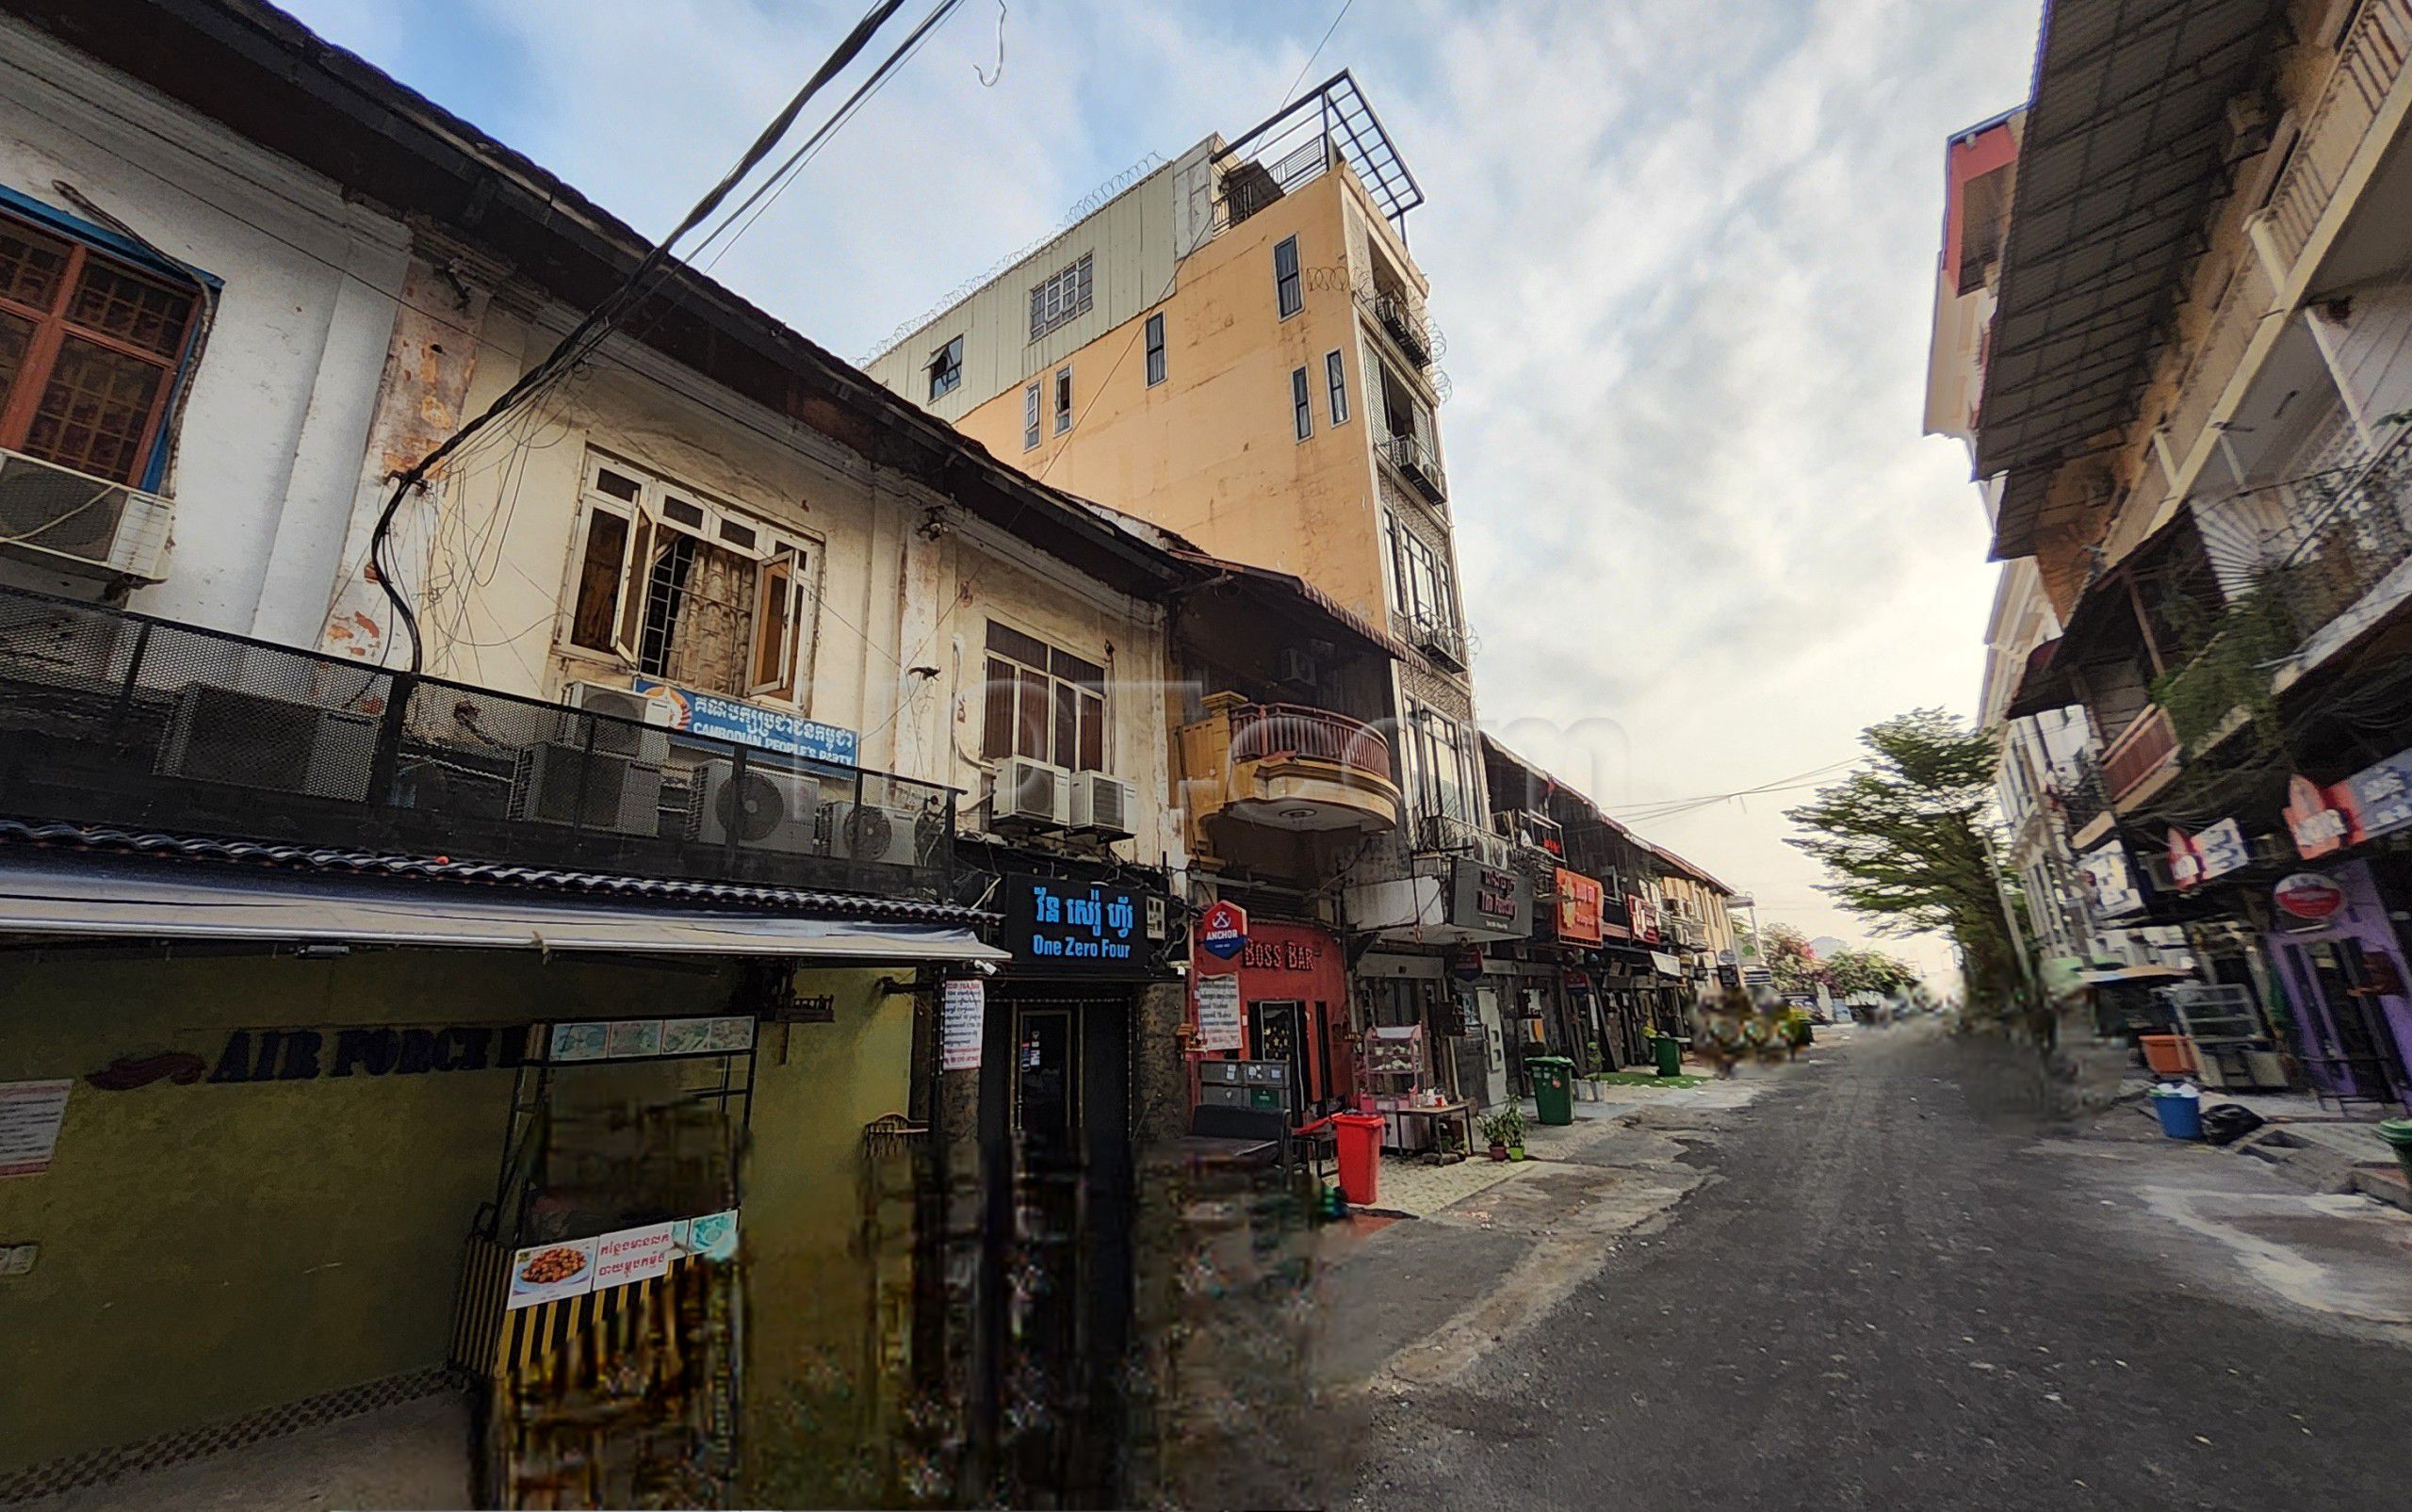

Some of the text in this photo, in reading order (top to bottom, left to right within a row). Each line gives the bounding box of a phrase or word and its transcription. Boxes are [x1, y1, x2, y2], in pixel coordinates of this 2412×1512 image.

[693, 722, 853, 767] CAMBODIAN PEOPLE'S PARTY
[1033, 934, 1132, 959] One Zero Four
[1206, 929, 1238, 941] ANCHOR
[1245, 937, 1314, 970] BOSS BAR
[205, 1029, 324, 1083] AIR
[327, 1027, 493, 1079] FORCE
